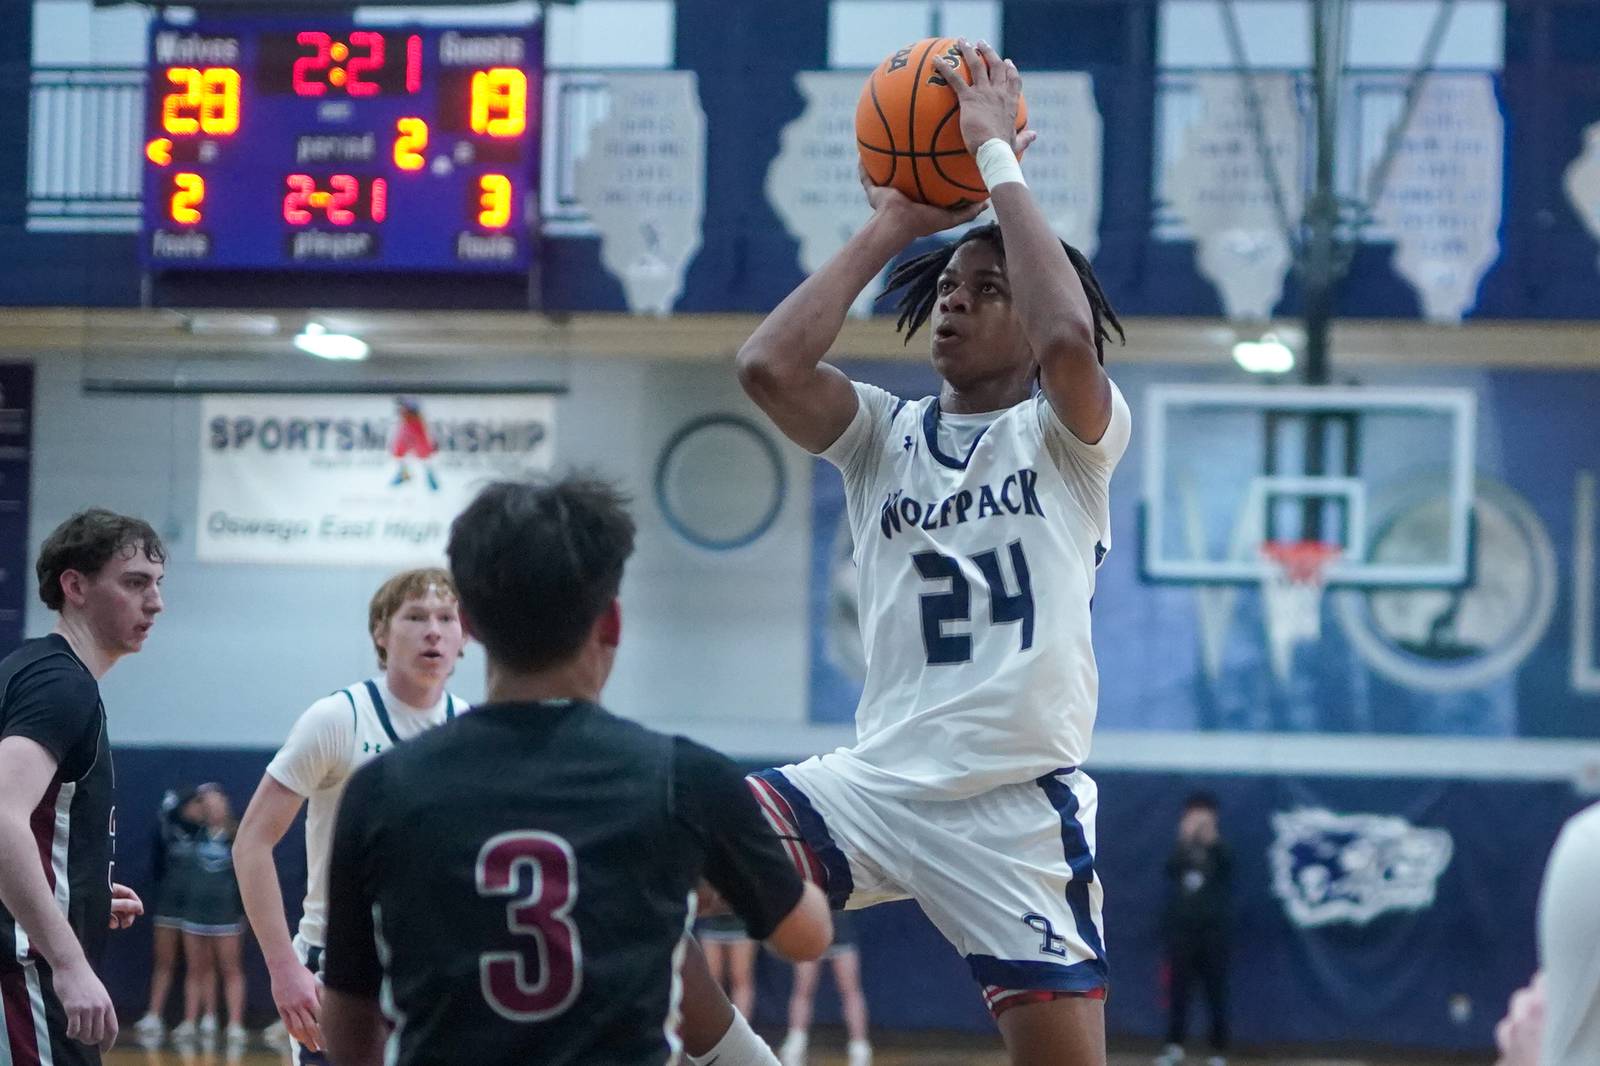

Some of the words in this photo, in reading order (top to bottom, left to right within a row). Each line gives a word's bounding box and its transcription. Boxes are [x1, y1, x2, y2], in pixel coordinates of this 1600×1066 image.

[156, 33, 239, 63] Wolves
[297, 134, 374, 161] period
[394, 117, 428, 171] 2
[171, 172, 204, 224] 2
[478, 173, 511, 228] 3
[210, 415, 547, 452] SPORTSMNSHIP
[880, 468, 1047, 540] WOLFPACK
[909, 536, 1035, 667] 24
[475, 829, 583, 1022] 3
